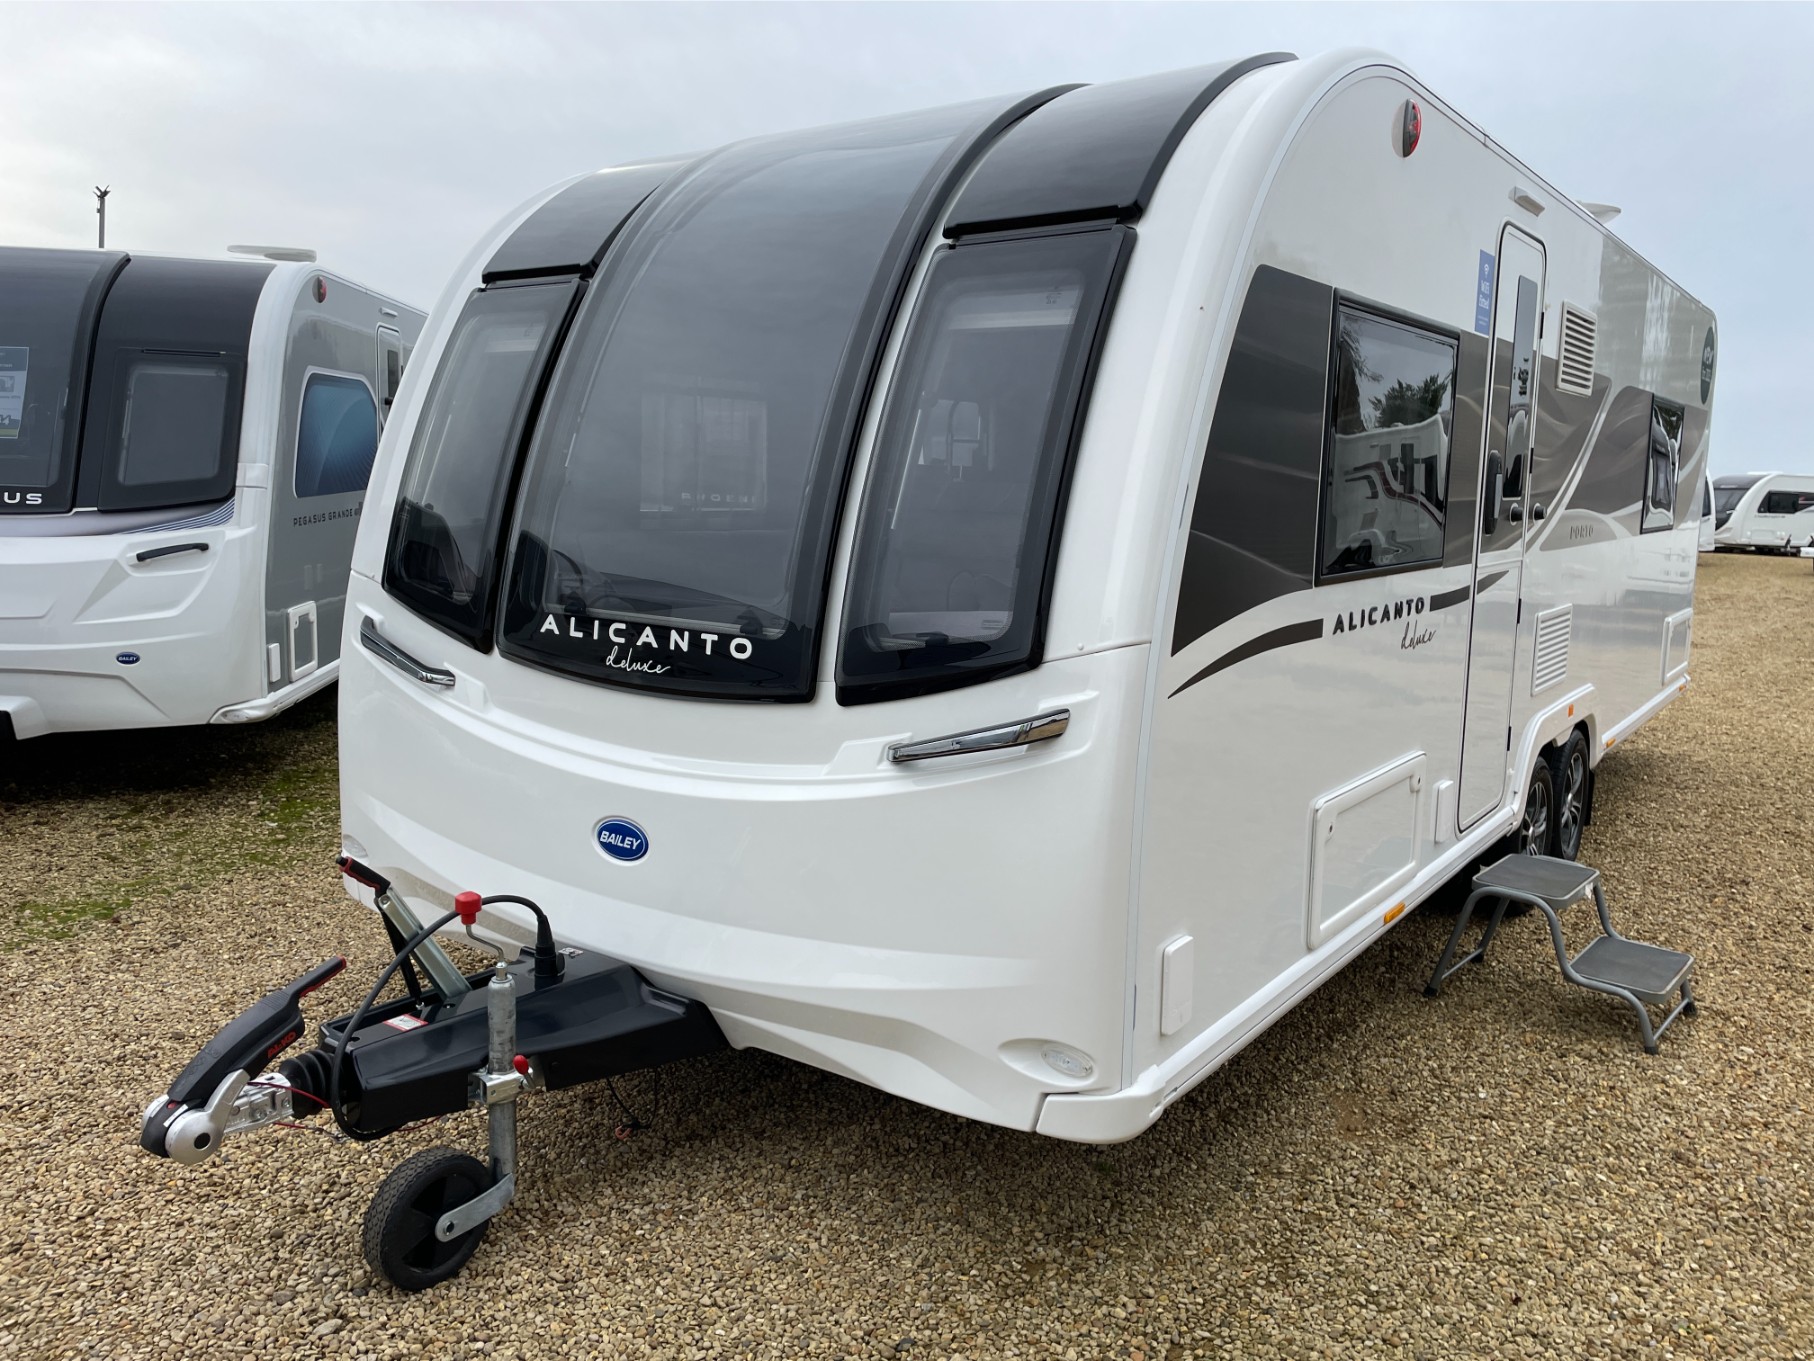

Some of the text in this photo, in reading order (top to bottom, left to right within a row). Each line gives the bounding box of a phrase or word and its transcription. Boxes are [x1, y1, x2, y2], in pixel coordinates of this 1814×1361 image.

[3, 491, 42, 505] US
[293, 512, 326, 527] PEGASUS
[328, 508, 353, 521] GRANDE
[1332, 597, 1425, 635] ALICANTO
[540, 613, 753, 660] ALICANTO
[1401, 619, 1436, 650] deluxe
[605, 645, 671, 674] deluxe
[600, 830, 641, 850] BAILEY
